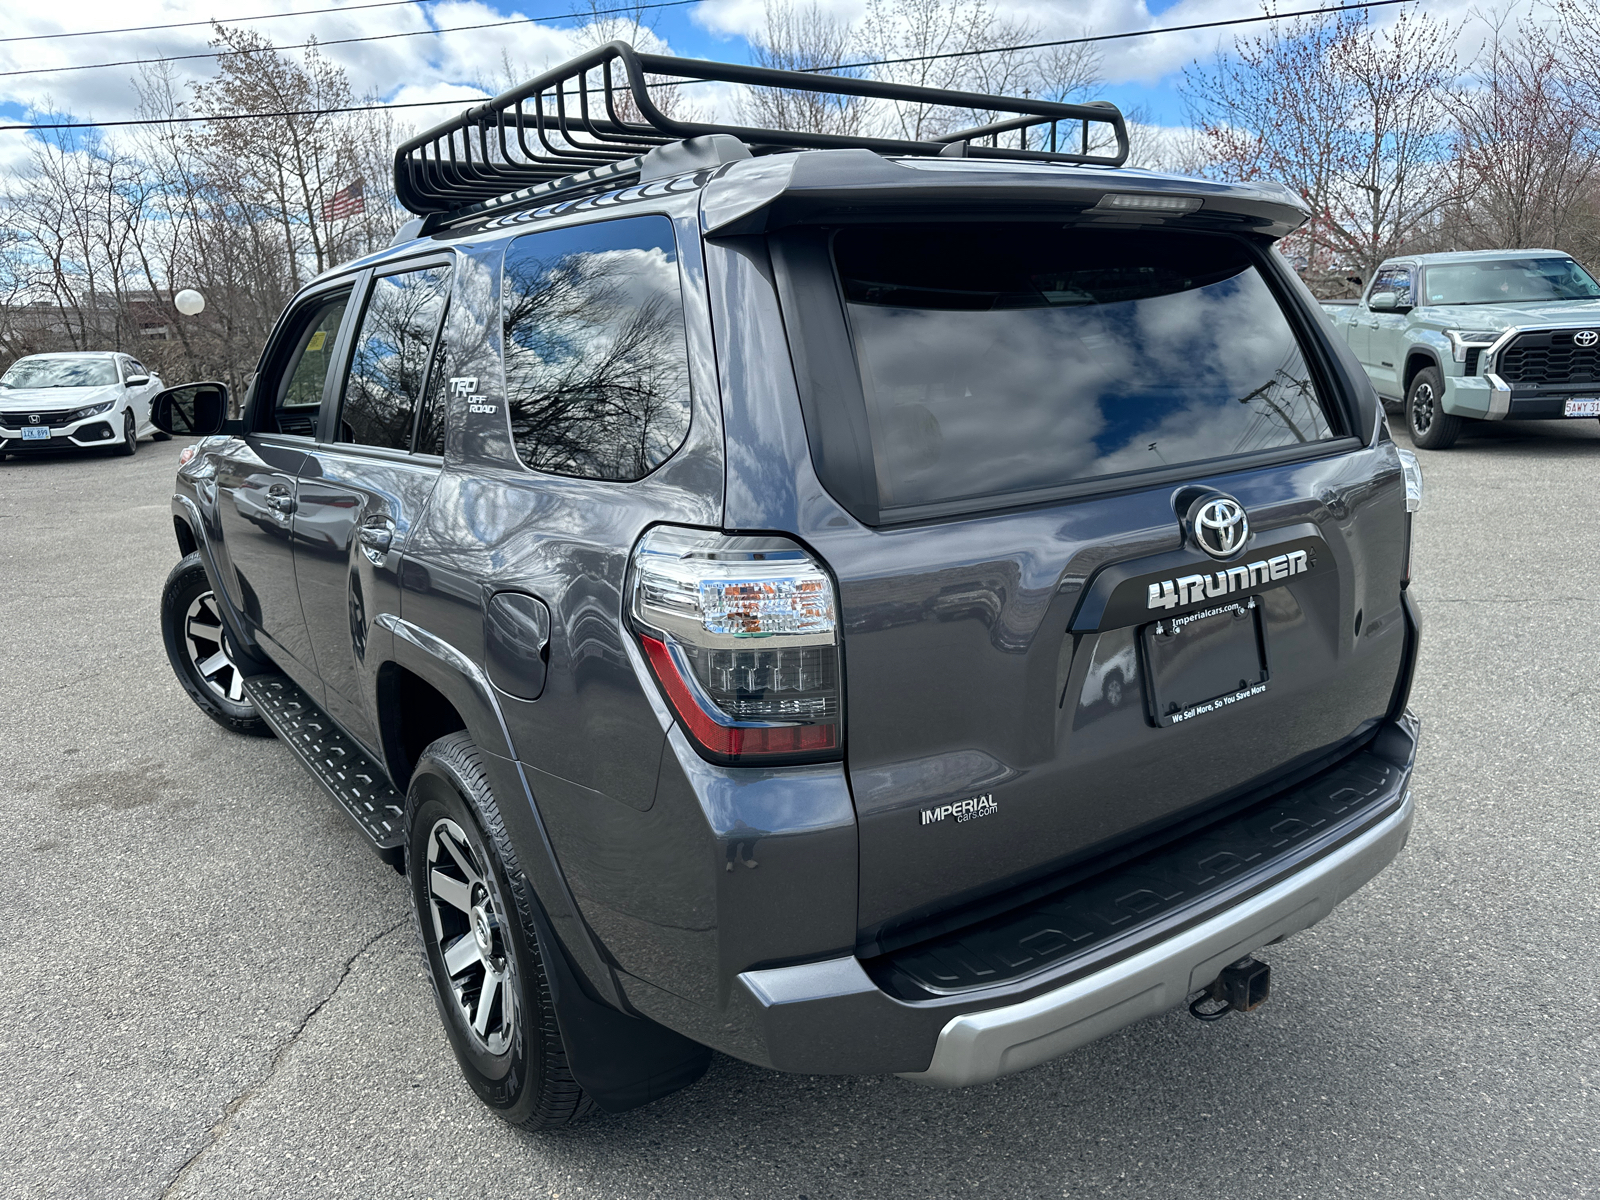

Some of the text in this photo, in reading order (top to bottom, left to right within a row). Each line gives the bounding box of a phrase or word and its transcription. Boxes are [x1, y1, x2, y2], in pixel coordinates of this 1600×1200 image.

[449, 377, 479, 397] TRD
[467, 395, 488, 404] OFF
[469, 404, 497, 414] ROAD
[1566, 402, 1588, 412] 5AWY
[1171, 602, 1241, 627] Imperialcars.com
[1172, 684, 1266, 724] We Sell More, So You Save More
[920, 793, 998, 826] IMPERIAL
[957, 805, 998, 823] cars.com
